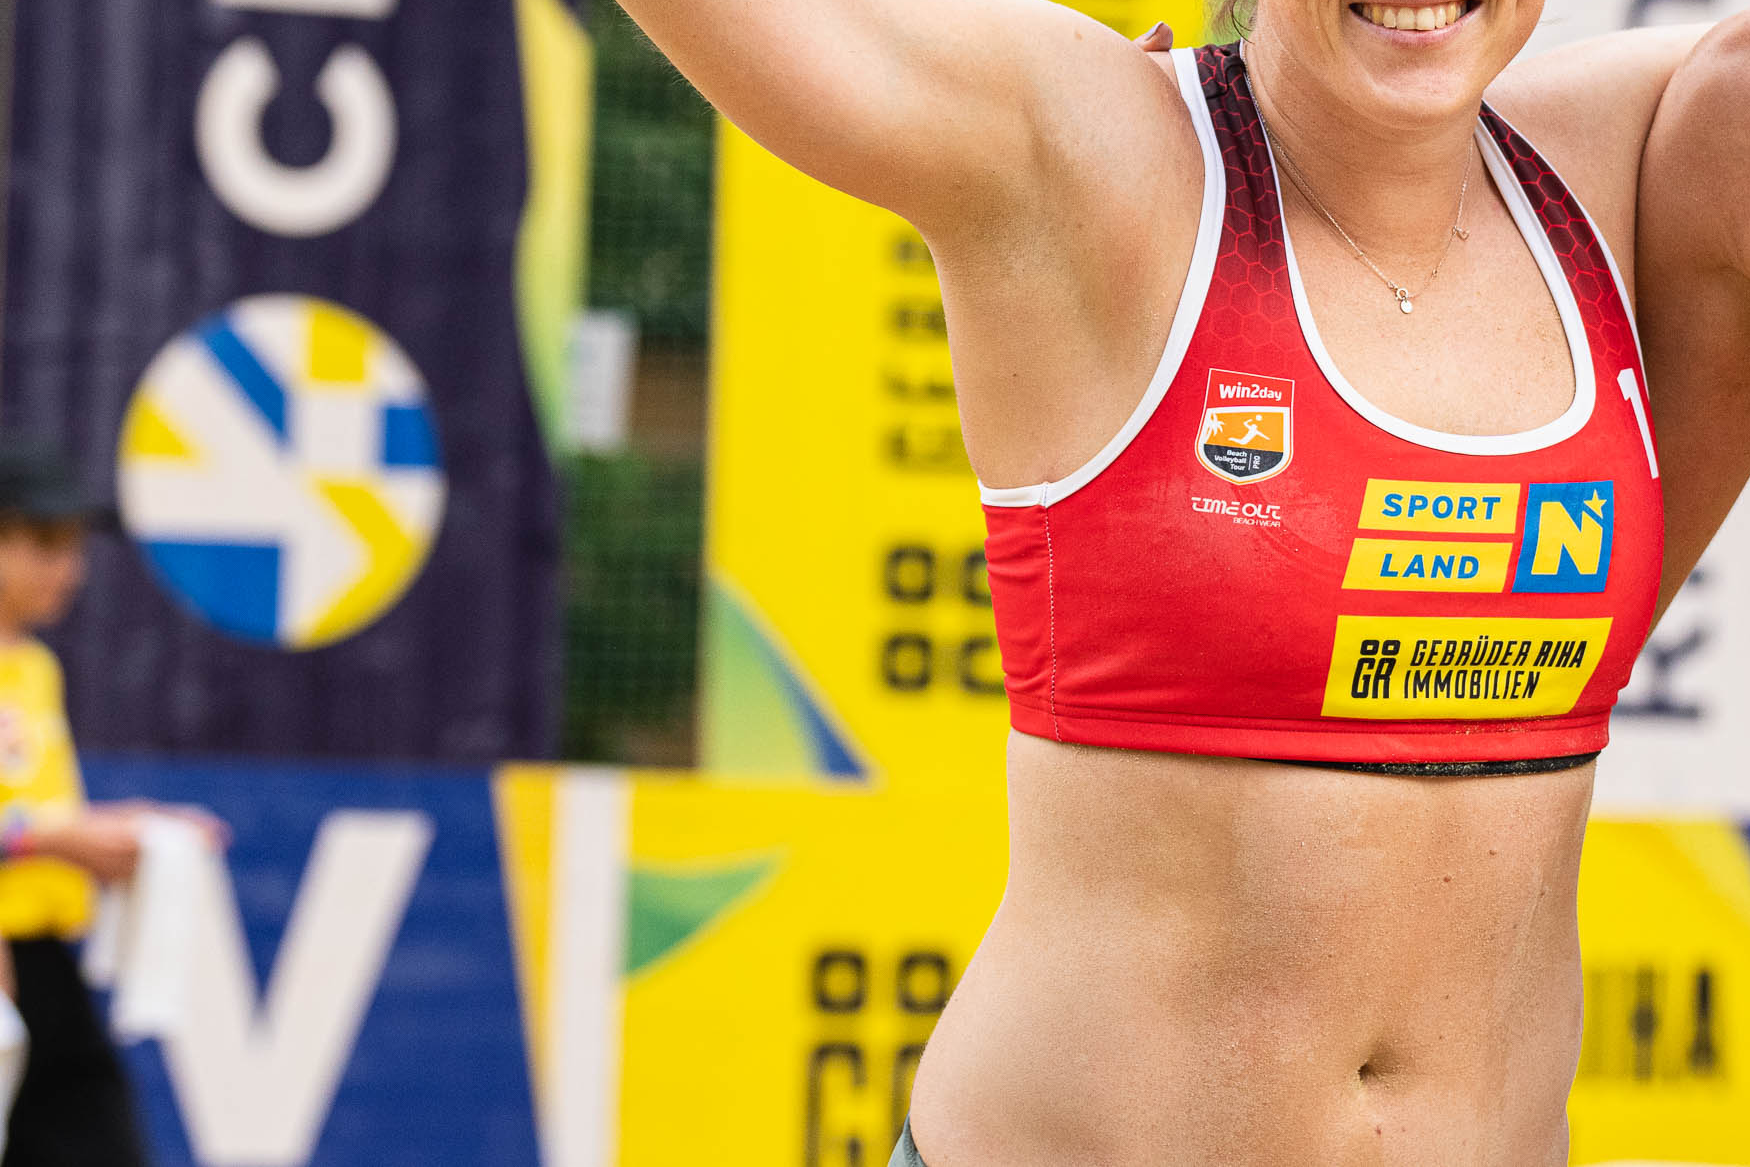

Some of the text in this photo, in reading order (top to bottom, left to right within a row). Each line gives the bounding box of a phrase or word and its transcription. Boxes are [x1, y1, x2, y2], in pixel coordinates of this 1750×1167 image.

[1616, 367, 1659, 479] 1
[1214, 454, 1247, 465] Volleyball
[1226, 449, 1248, 458] Beach
[1252, 455, 1261, 470] PRO
[1230, 463, 1246, 471] Tour
[1191, 496, 1281, 520] TIME OUT
[1381, 493, 1501, 520] SPORT
[1531, 501, 1604, 575] N
[1379, 553, 1480, 579] LAND
[1409, 635, 1588, 669] GEBRÜDER RIHA
[1403, 670, 1541, 700] IMMOBILIEN
